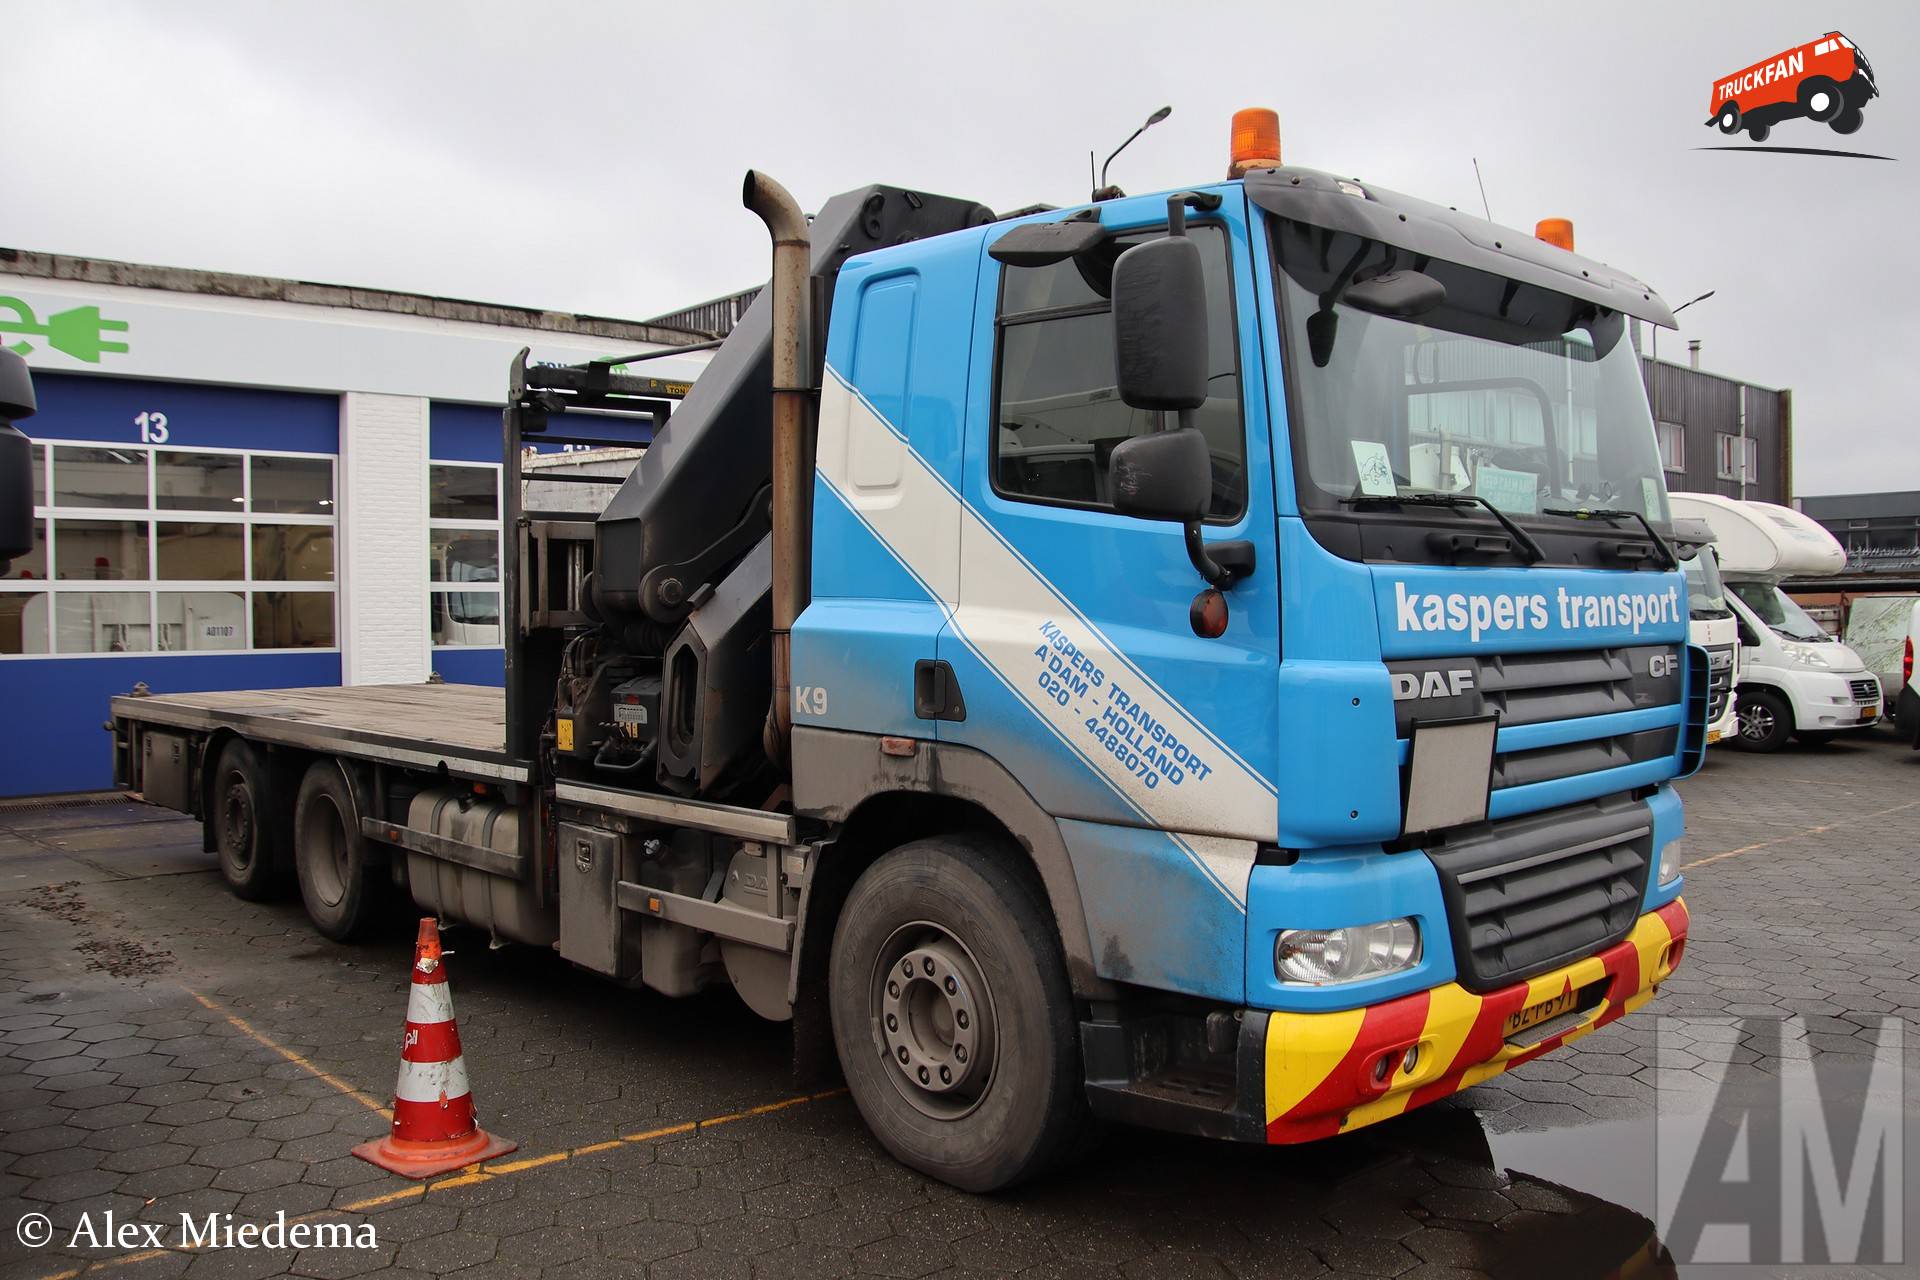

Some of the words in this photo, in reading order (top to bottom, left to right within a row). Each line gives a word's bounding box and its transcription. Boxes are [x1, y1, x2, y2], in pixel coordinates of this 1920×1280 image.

[134, 411, 169, 443] 13
[1395, 582, 1548, 642] kaspers
[1558, 586, 1679, 635] transport
[1390, 669, 1474, 700] DAF
[1649, 654, 1679, 678] CF
[796, 686, 828, 715] K9
[1038, 620, 1105, 688] KASPERS
[1108, 681, 1212, 783] TRANSPORT
[1038, 671, 1070, 707] 020
[1084, 717, 1160, 790] 4488070
[1102, 703, 1186, 786] HOLLAND
